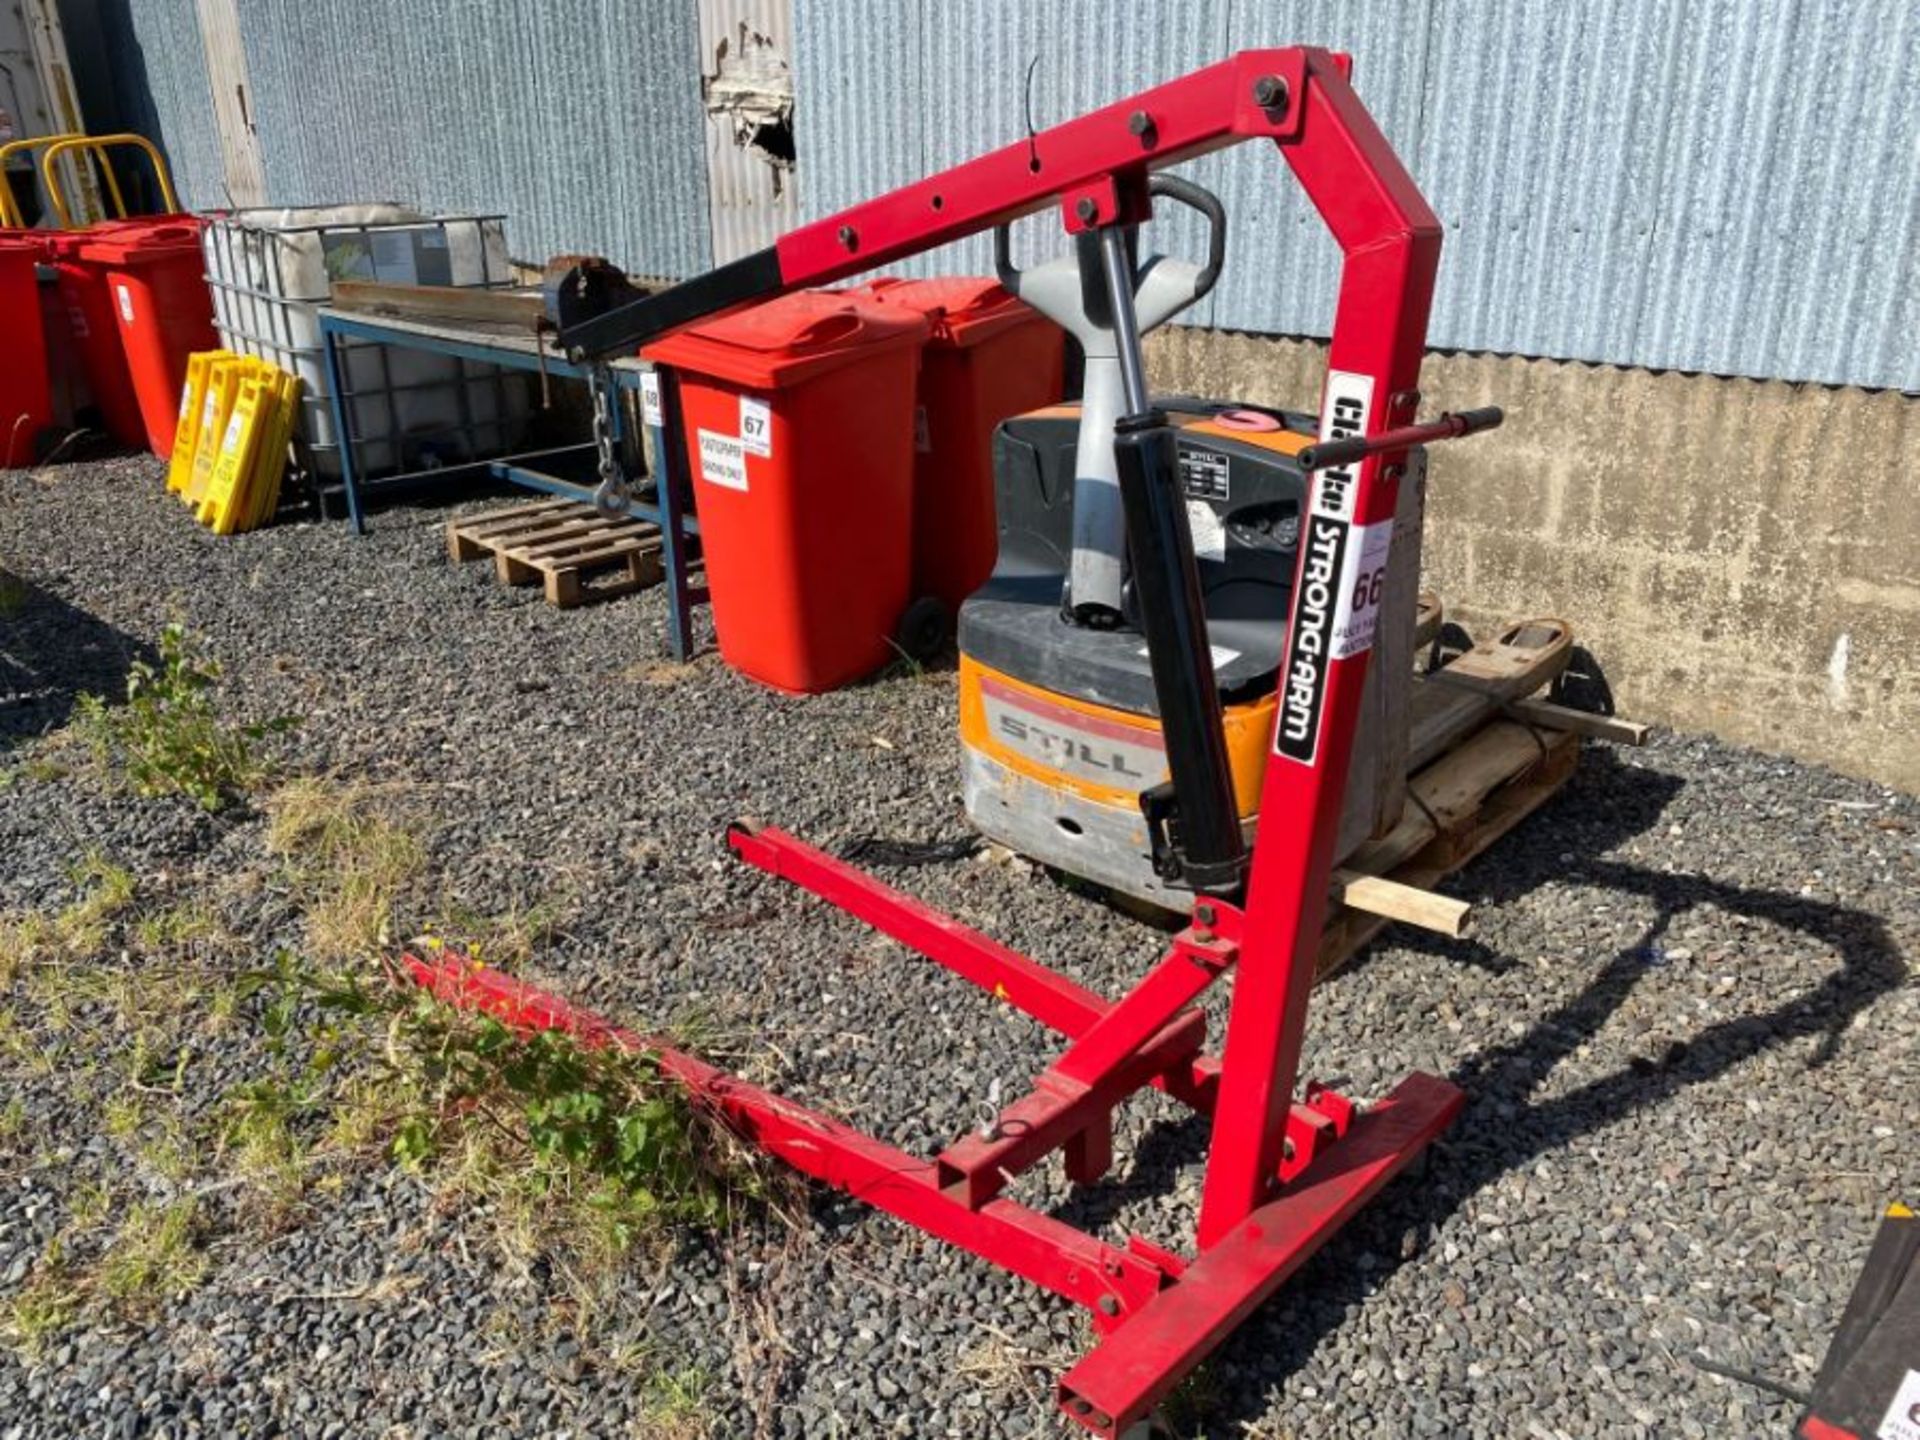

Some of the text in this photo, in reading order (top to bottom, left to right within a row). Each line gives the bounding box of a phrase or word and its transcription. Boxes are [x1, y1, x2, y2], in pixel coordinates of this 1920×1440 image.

[743, 416, 765, 436] 67
[1352, 567, 1385, 613] 66
[1000, 715, 1143, 778] STILL
